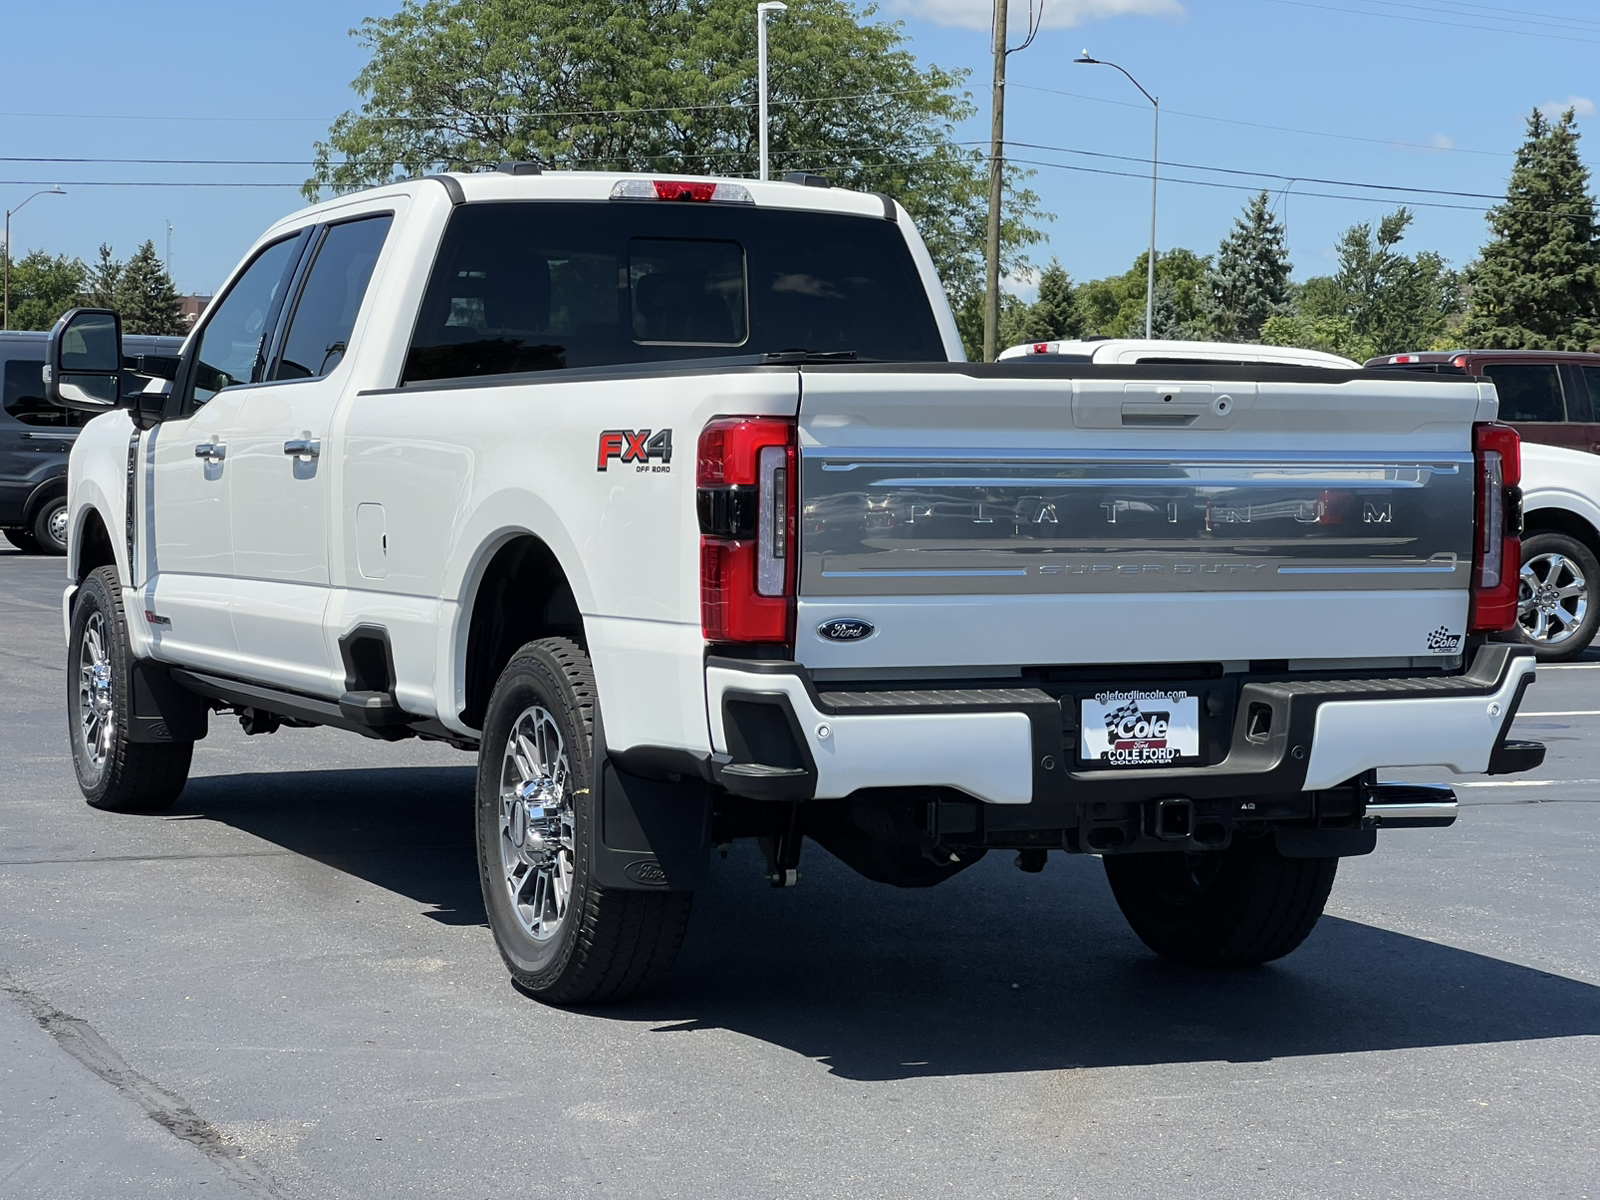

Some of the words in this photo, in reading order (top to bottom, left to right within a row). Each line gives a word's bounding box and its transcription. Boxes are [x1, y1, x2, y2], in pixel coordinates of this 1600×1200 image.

[597, 429, 672, 472] FX4
[905, 502, 1392, 523] PLATINUM
[1039, 564, 1164, 575] SUPER
[1173, 563, 1267, 574] DUTY
[831, 623, 863, 637] Ford
[1432, 637, 1458, 648] Cole
[1095, 690, 1188, 700] colefordlincoln.com
[1117, 715, 1168, 738] Cole
[1133, 741, 1150, 749] Ford
[1108, 749, 1140, 760] COLE
[1143, 748, 1175, 760] FORD
